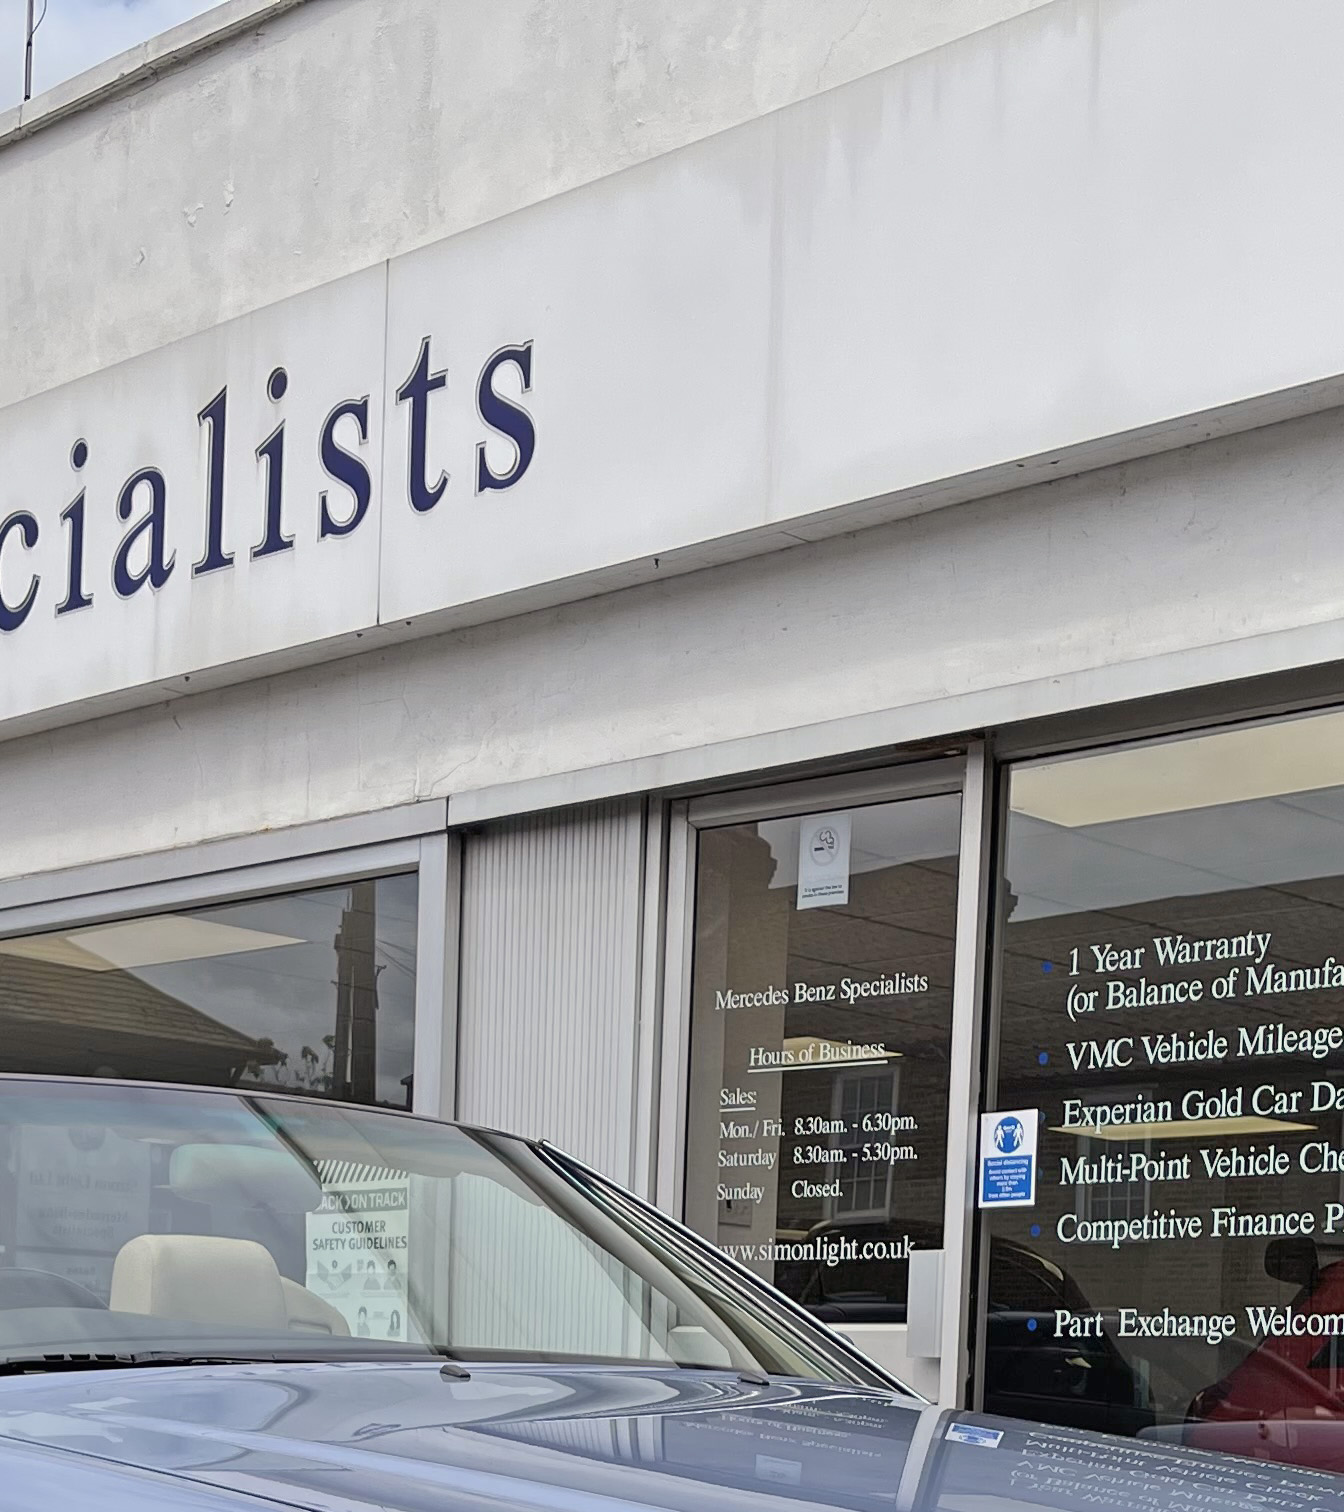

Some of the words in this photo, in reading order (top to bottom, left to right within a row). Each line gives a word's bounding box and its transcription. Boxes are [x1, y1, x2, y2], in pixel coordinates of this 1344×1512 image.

[1068, 948, 1080, 976] 1
[1090, 944, 1145, 973] Year
[1153, 929, 1272, 968] Warranty
[715, 985, 789, 1010] Mercedes
[794, 982, 835, 1004] Benz
[840, 972, 929, 1005] Specialists
[1066, 983, 1099, 1021] (or
[1105, 977, 1203, 1011] Balance
[1212, 966, 1238, 1000] of
[750, 1047, 794, 1067] Hours
[798, 1043, 815, 1062] of
[818, 1040, 885, 1061] Business
[1067, 1037, 1134, 1070] VMC
[1142, 1028, 1229, 1064] Vehicle
[1237, 1018, 1343, 1059] Mileage
[719, 1088, 756, 1106] Sales:
[1062, 1093, 1172, 1135] Experian
[1181, 1086, 1244, 1120] Gold
[1252, 1082, 1302, 1116] Car
[794, 1117, 847, 1135] 8.30am.
[862, 1113, 918, 1137] 6.30pm.
[717, 1150, 777, 1169] Saturday
[793, 1147, 847, 1165] 8.30am.
[862, 1143, 918, 1165] 5.30pm.
[1059, 1151, 1190, 1186] Multi-Point
[1199, 1145, 1290, 1180] Vehicle
[369, 1190, 406, 1208] TRACK
[717, 1183, 765, 1204] Sunday
[791, 1178, 843, 1199] Closed.
[331, 1220, 386, 1235] CUSTOMER
[1056, 1207, 1202, 1248] Competitive
[1210, 1204, 1315, 1239] Finance
[312, 1237, 347, 1251] SAFETY
[348, 1235, 407, 1250] GUIDELINES
[1054, 1309, 1103, 1338] Part
[1117, 1307, 1236, 1345] Exchange
